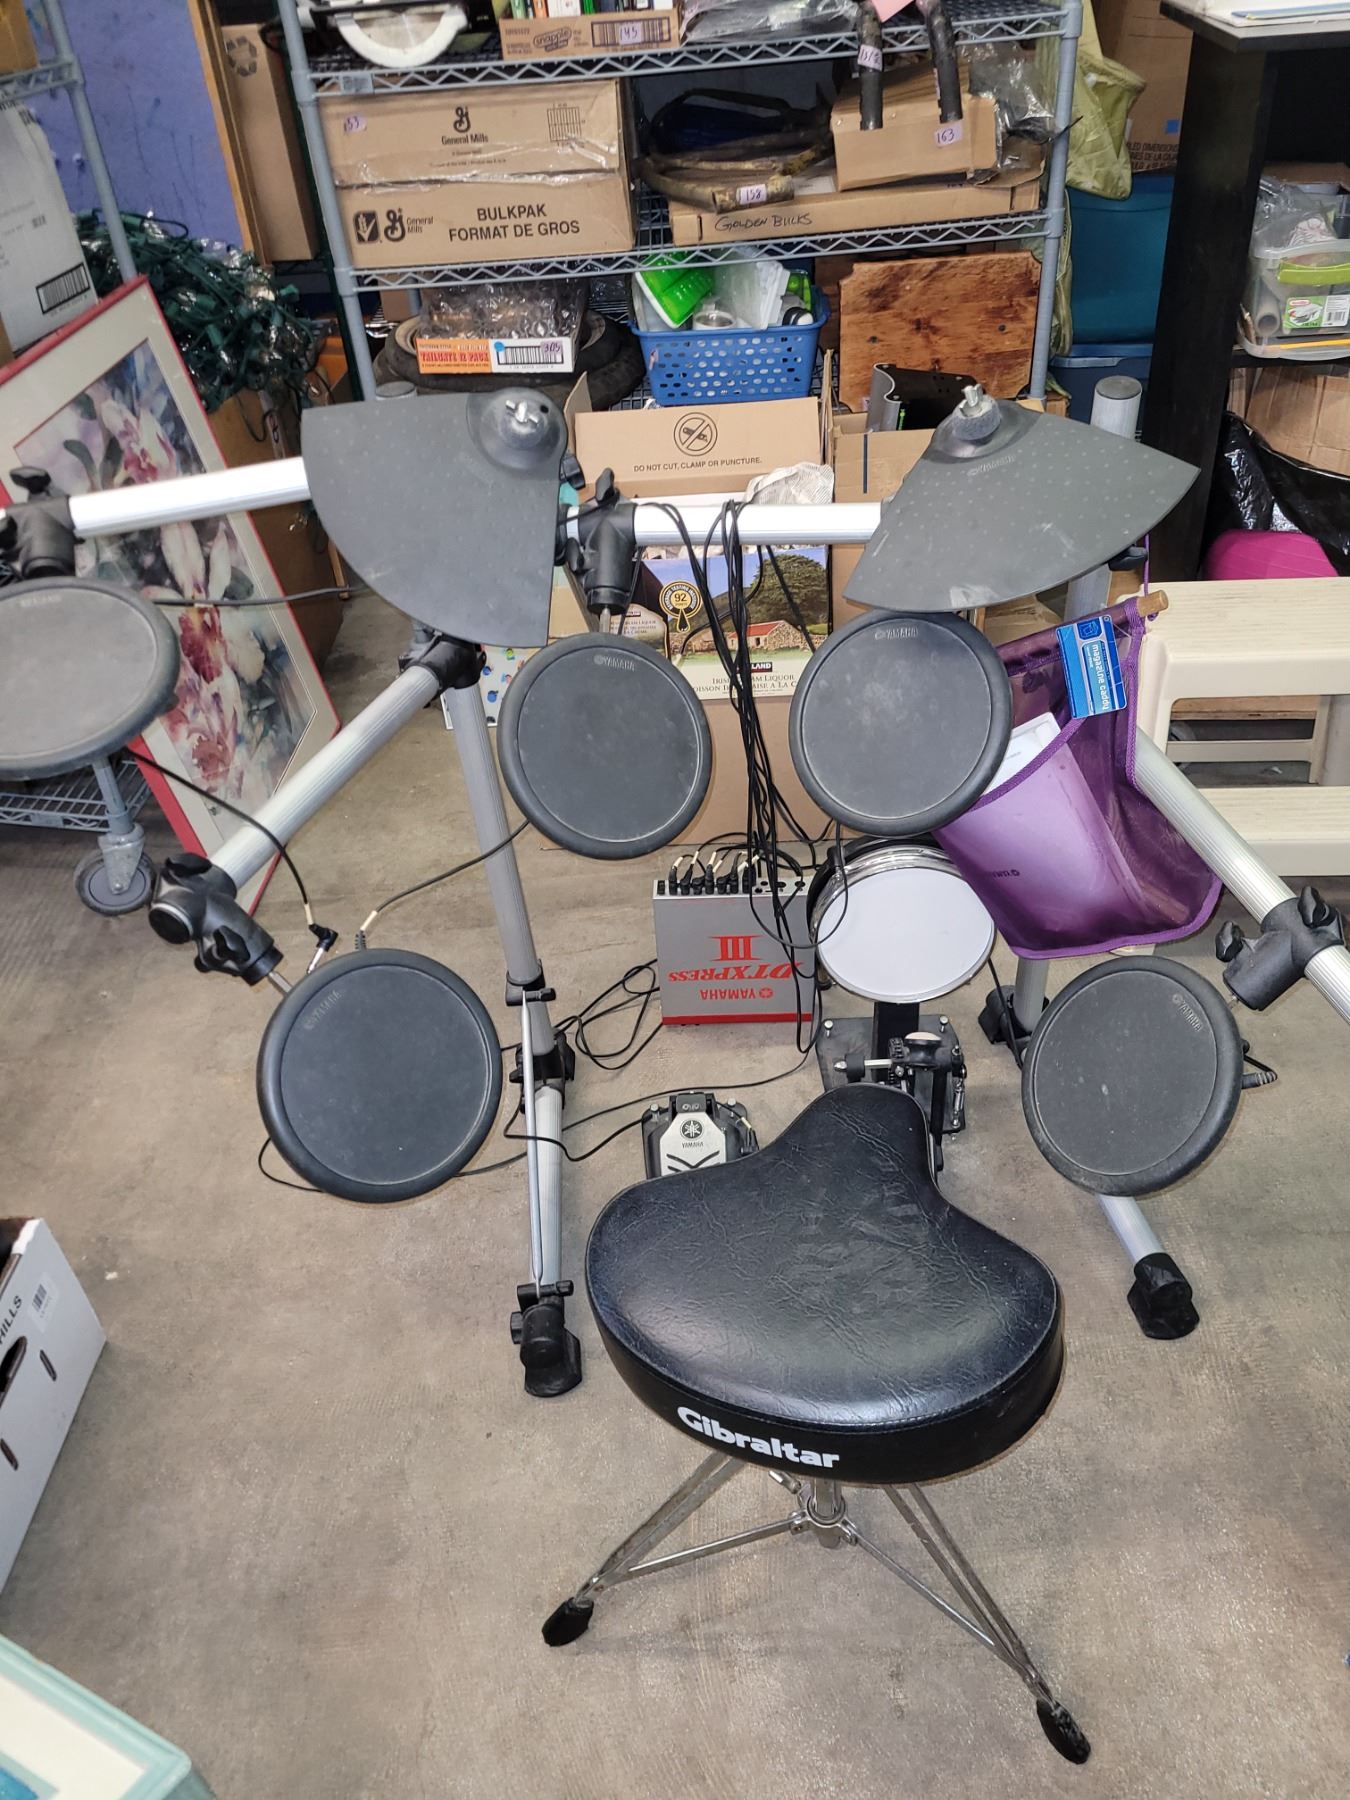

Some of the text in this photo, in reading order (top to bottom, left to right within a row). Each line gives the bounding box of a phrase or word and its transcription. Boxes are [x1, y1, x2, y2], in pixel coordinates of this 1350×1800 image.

[441, 134, 489, 146] General Mills
[937, 128, 955, 143] 163
[476, 203, 548, 222] BULKPAK
[406, 216, 434, 226] General
[715, 215, 768, 232] GOLDEN
[407, 225, 423, 234] Mills
[448, 220, 581, 243] FORMAT DE GROS
[680, 461, 707, 469] CLAMP
[720, 457, 763, 466] PUNCTURE.
[674, 592, 688, 602] 92
[1092, 643, 1105, 684] magazine
[1099, 685, 1110, 710] caddy
[667, 961, 804, 982] DTXPRESS
[700, 986, 756, 1000] YAMAHA
[682, 1141, 704, 1149] YAMAHA
[677, 1406, 840, 1468] Gibraltar
